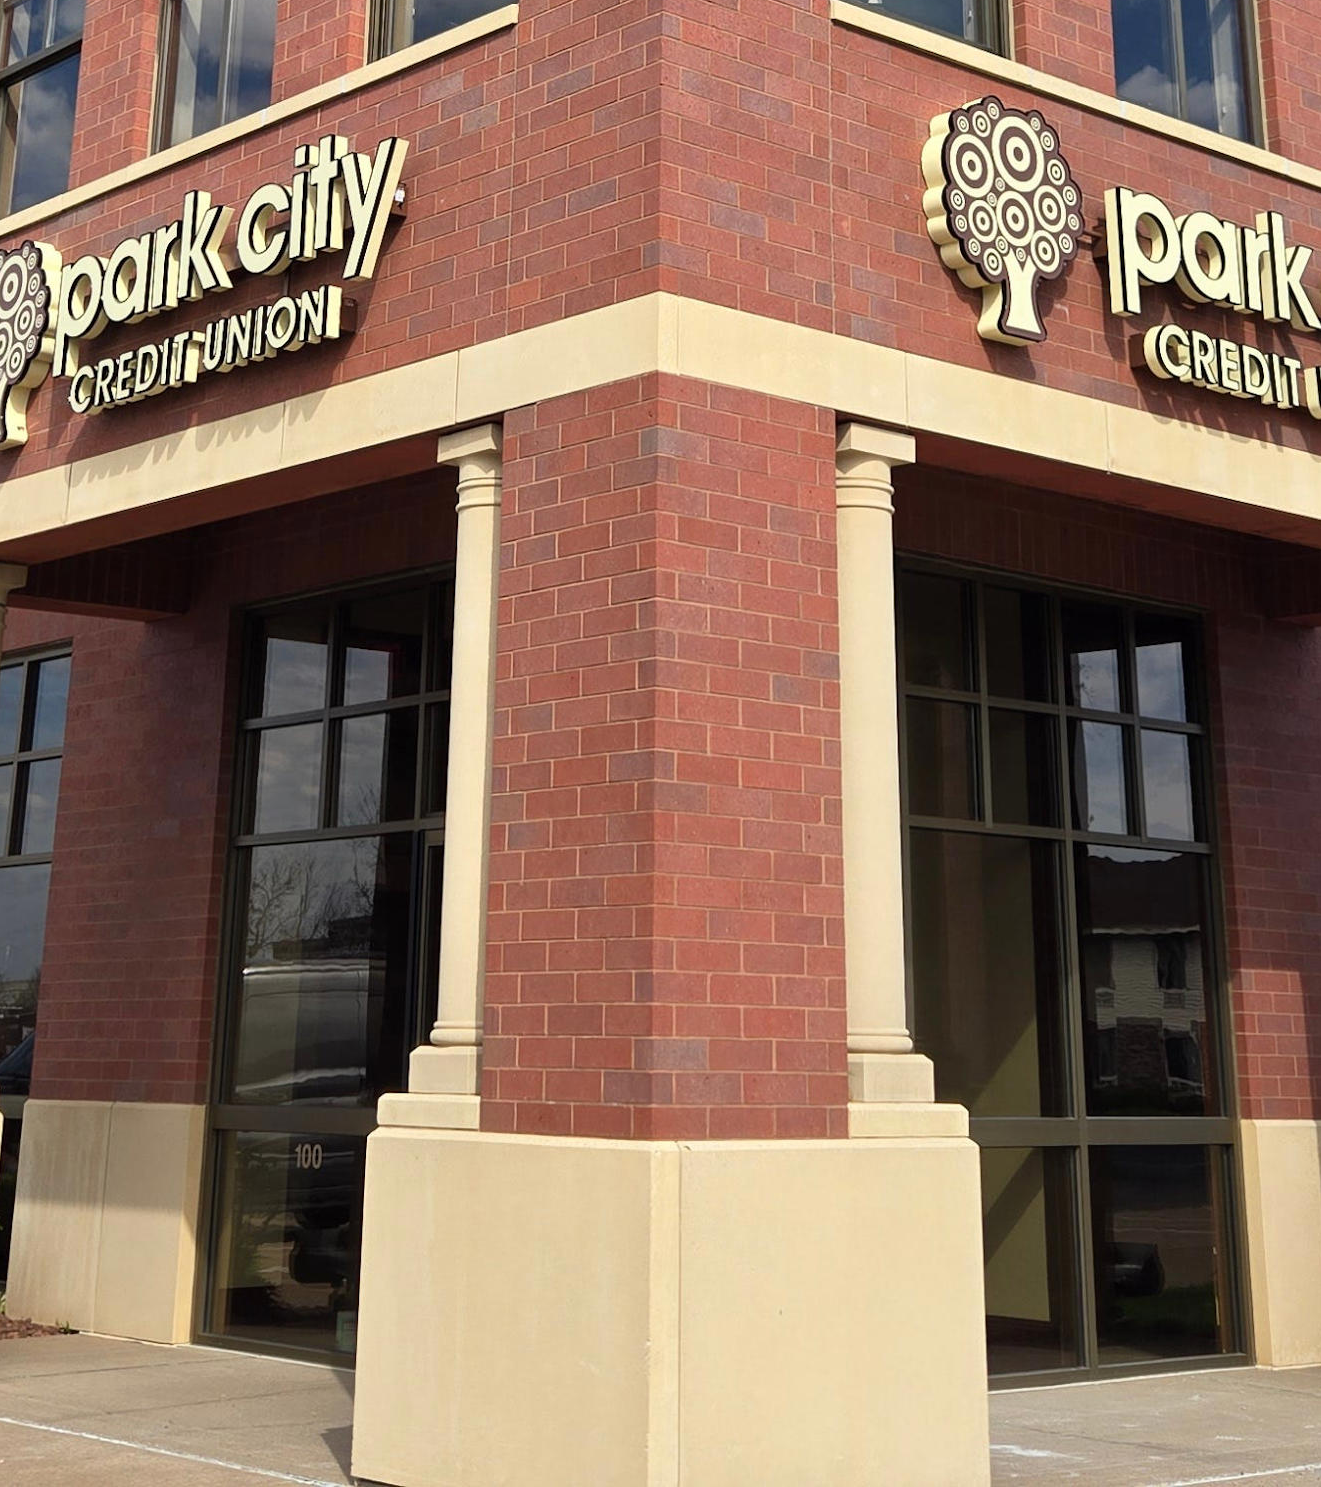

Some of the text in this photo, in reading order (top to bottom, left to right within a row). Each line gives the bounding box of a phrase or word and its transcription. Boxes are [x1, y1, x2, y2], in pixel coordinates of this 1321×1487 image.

[53, 134, 409, 378] park city
[69, 285, 342, 414] CREDIT UNION
[1144, 324, 1301, 409] CREDIT
[294, 1143, 323, 1169] 100
